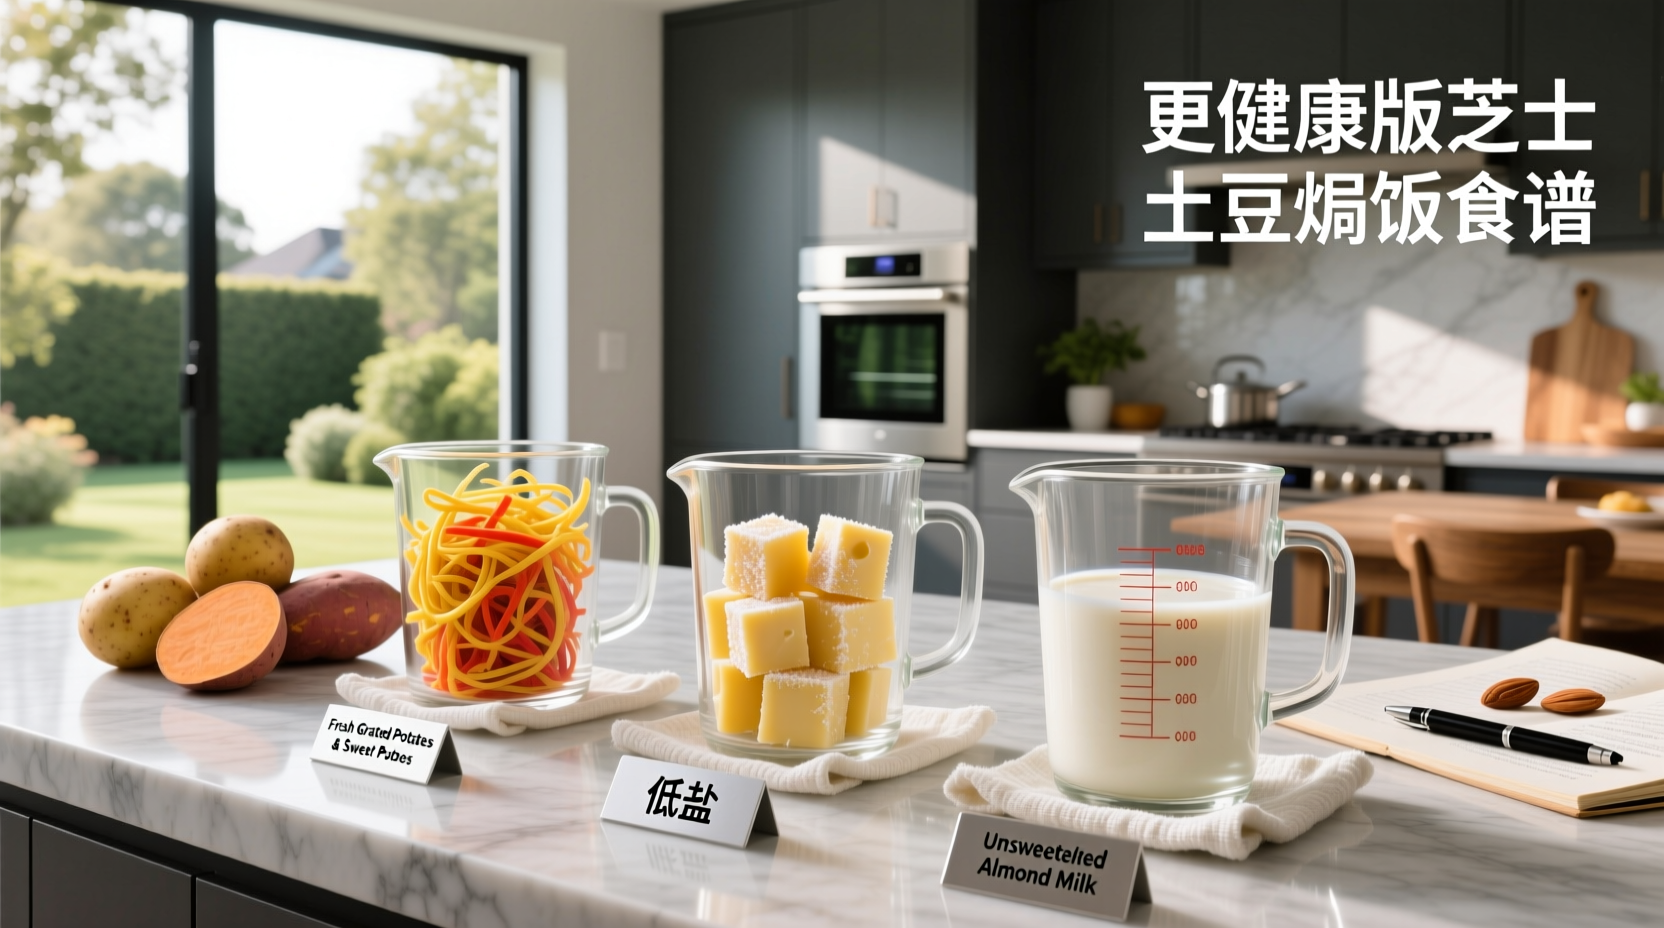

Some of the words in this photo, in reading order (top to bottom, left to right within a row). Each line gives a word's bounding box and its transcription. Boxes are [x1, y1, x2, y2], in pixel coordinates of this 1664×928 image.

[645, 775, 719, 825] 低盐
[976, 857, 1053, 887] Almond
[1054, 869, 1098, 896] Milk
